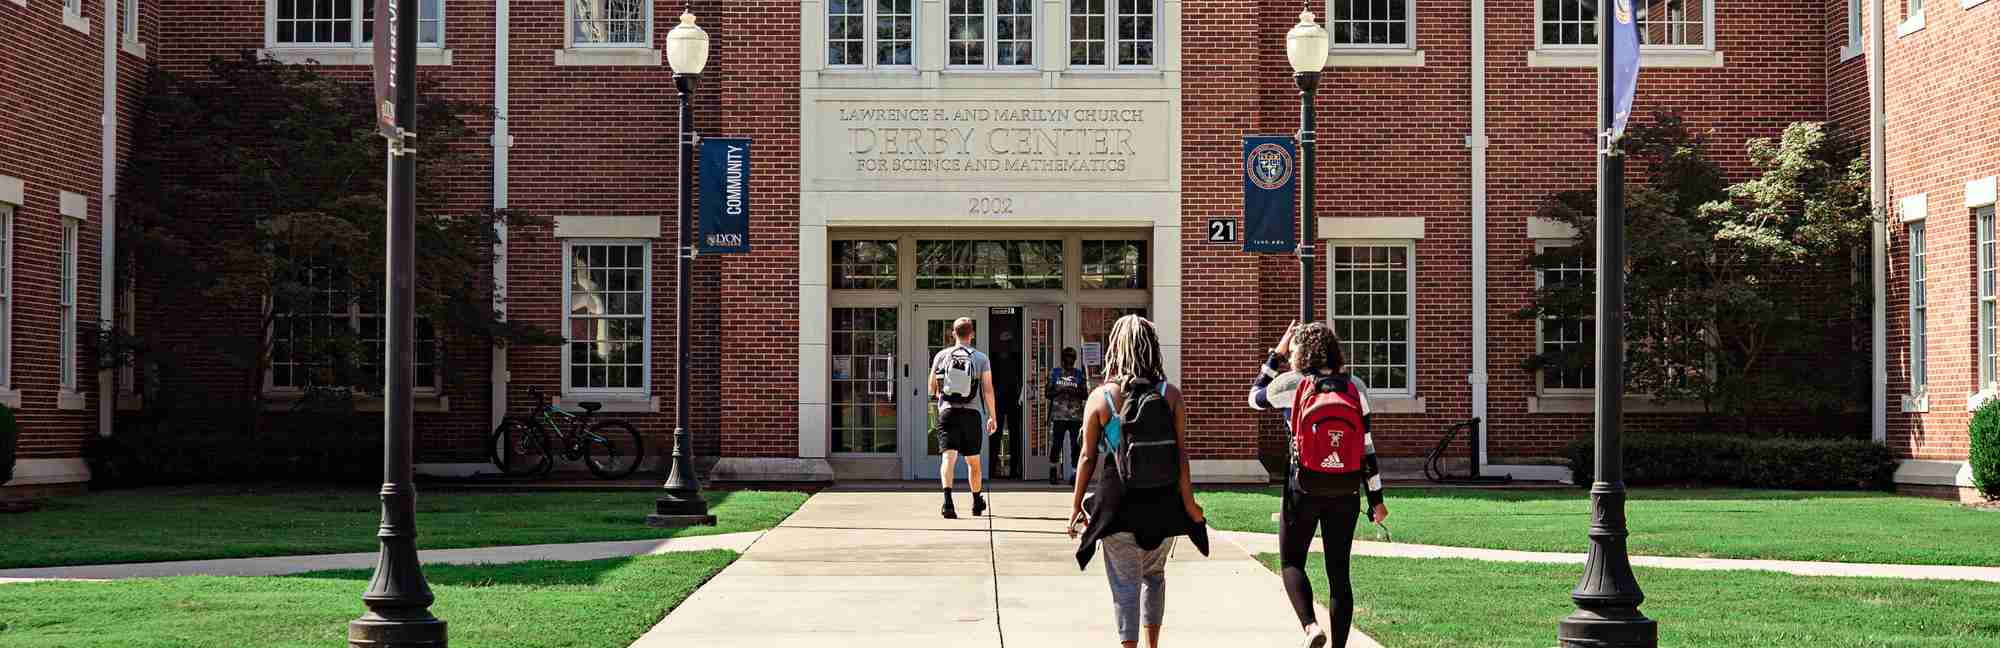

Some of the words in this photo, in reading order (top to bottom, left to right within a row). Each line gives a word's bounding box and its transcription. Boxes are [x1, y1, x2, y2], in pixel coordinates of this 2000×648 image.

[840, 108, 929, 121] LAWRENCE
[933, 108, 949, 121] H.
[953, 108, 990, 121] AND
[994, 109, 1069, 122] MARILYN
[1074, 109, 1144, 122] CHURCH
[848, 127, 975, 155] DERBY
[987, 127, 1136, 155] CENTER
[856, 159, 888, 172] FOR
[892, 159, 960, 172] SCIENCE
[964, 159, 1000, 172] AND
[1004, 159, 1127, 172] MATHEMATICS
[727, 145, 743, 215] COMMUNITY
[967, 197, 1013, 215] 2002
[1211, 221, 1234, 240] 21
[716, 233, 742, 247] LYON
